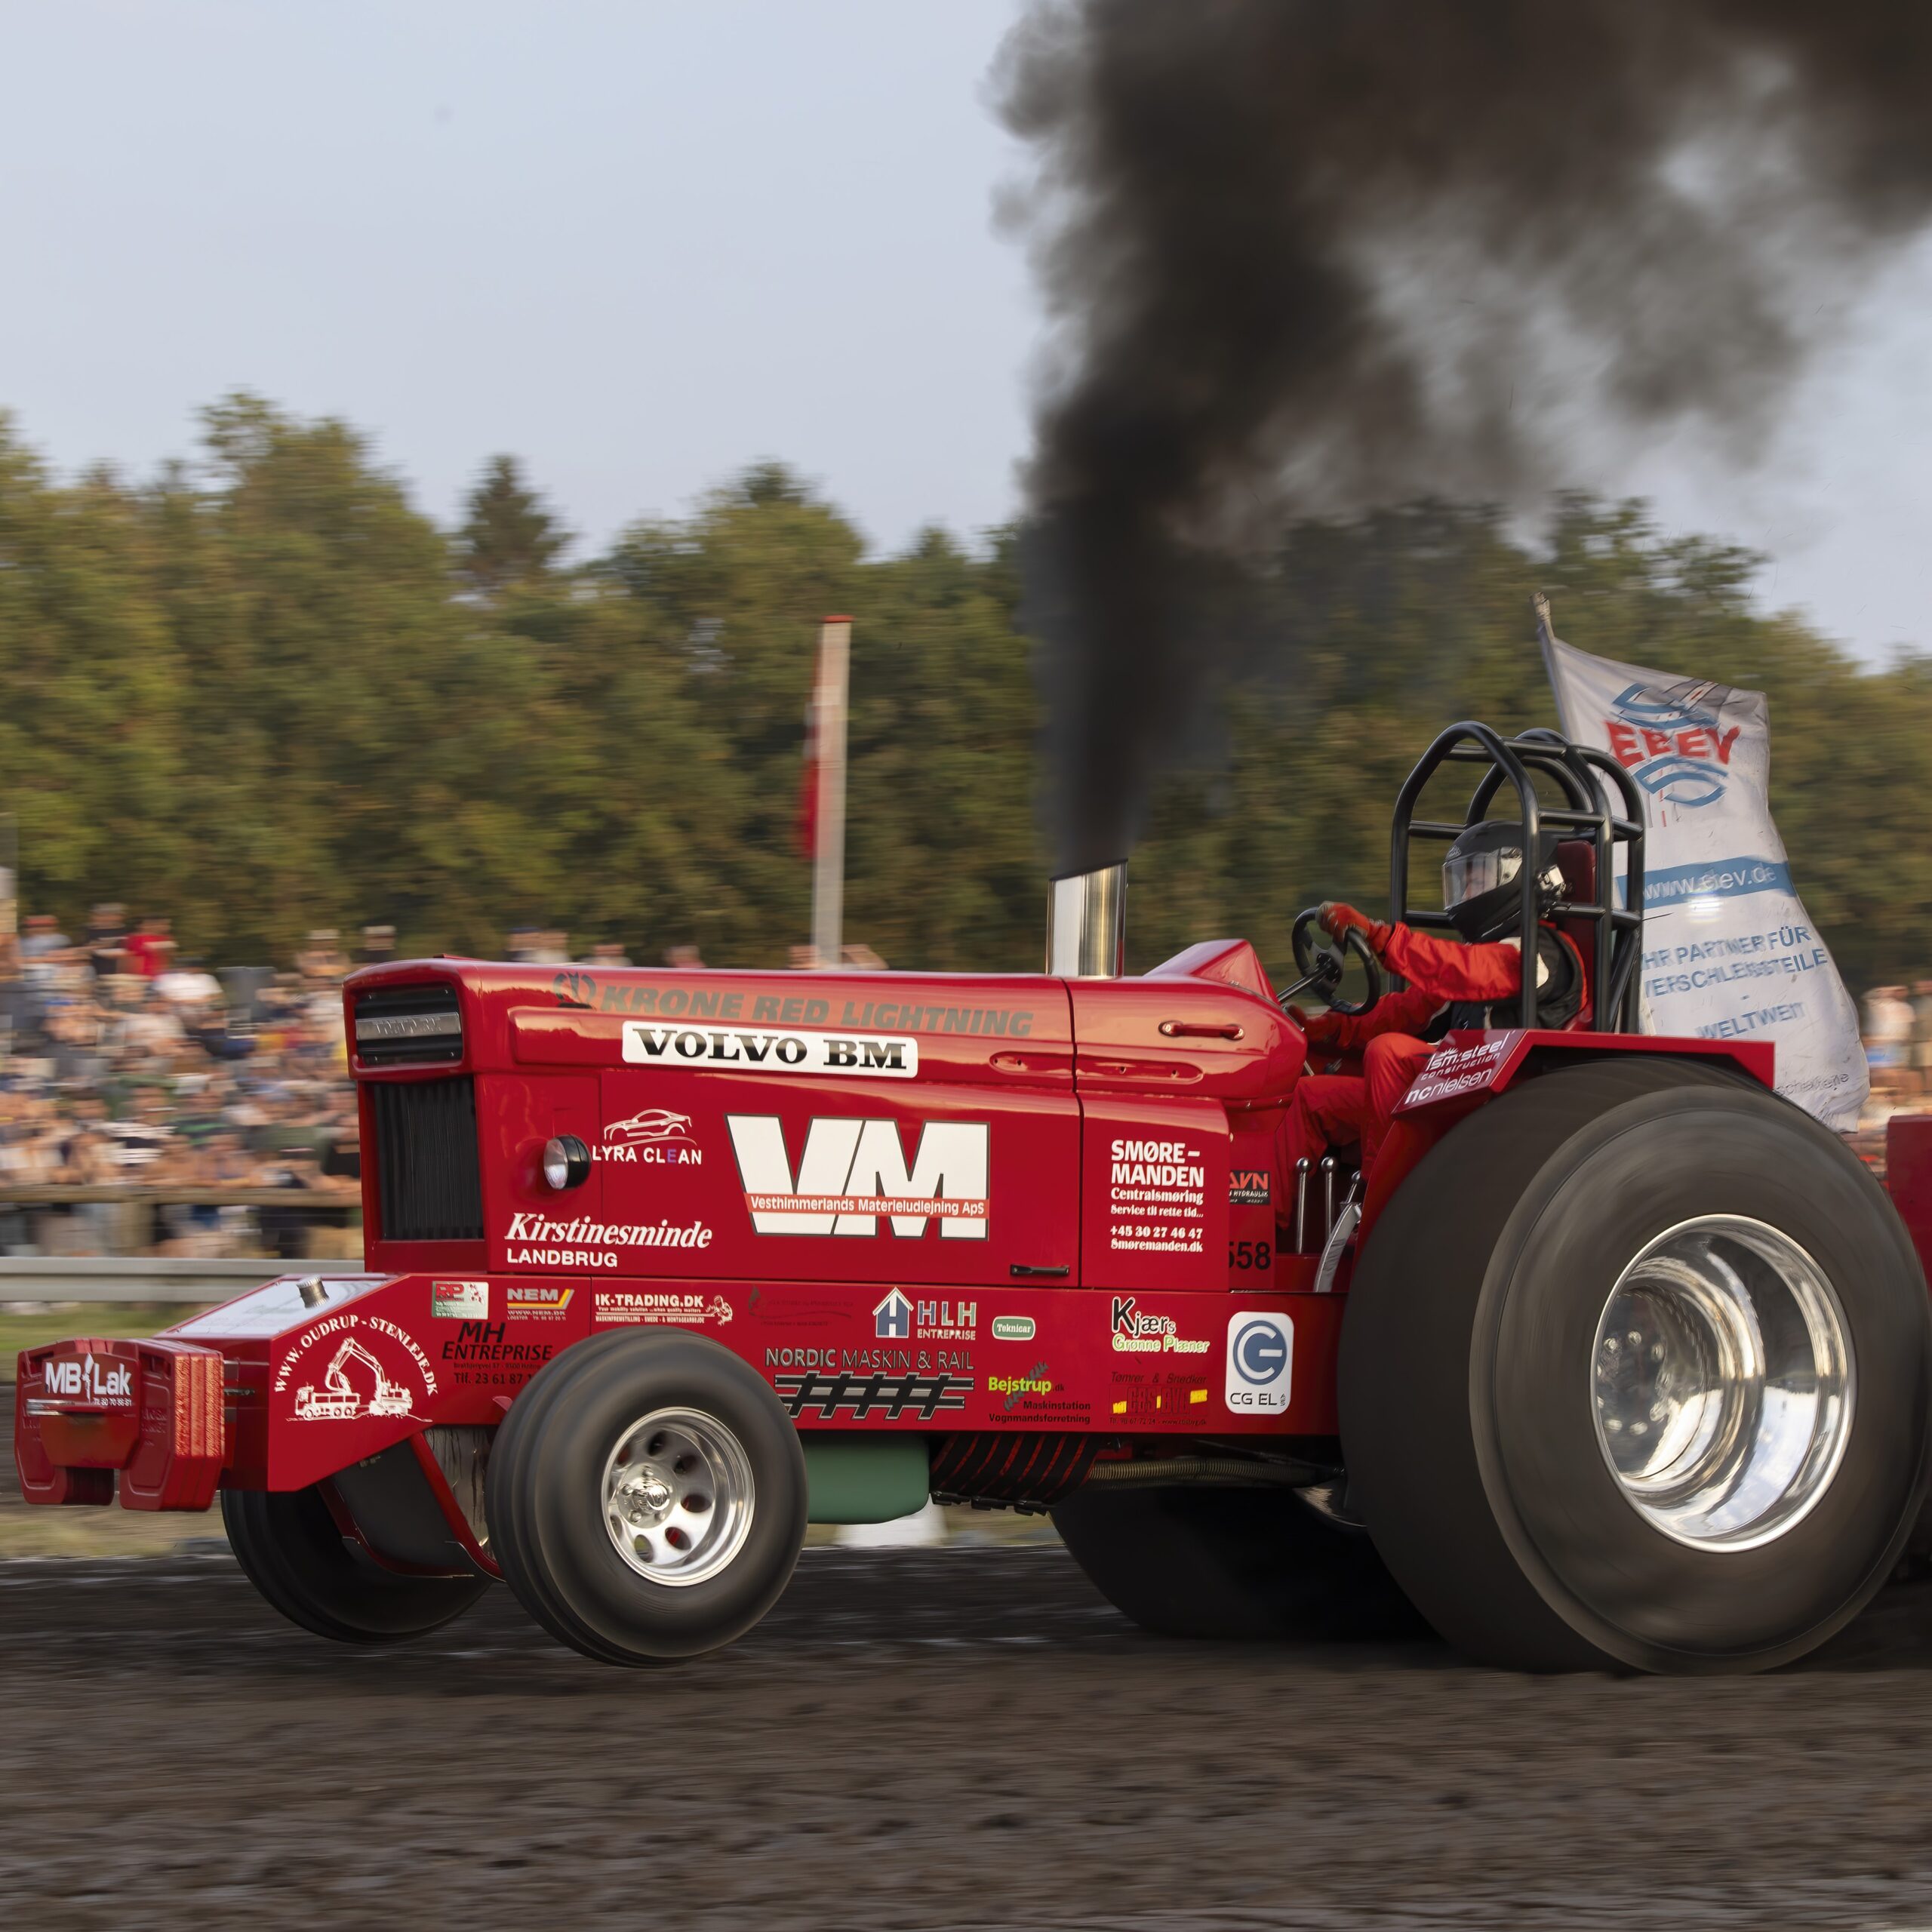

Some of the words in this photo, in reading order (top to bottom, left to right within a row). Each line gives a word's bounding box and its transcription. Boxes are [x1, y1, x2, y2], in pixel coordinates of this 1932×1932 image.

[1641, 948, 1673, 971] HR
[1767, 925, 1812, 950] FÜR
[601, 986, 744, 1018] KRONE
[752, 995, 829, 1025] RED
[840, 1001, 1034, 1036] LIGHTNING
[632, 1029, 808, 1064] VOLVO
[823, 1039, 906, 1069] BM
[1421, 1052, 1500, 1081] construction
[592, 1145, 637, 1162] LYRA
[643, 1147, 702, 1164] CLEAN
[1111, 1163, 1204, 1187] MANDEN
[751, 1195, 854, 1211] Vesthimmerlands
[859, 1198, 958, 1216] Materieludlejning
[962, 1201, 984, 1216] ApS
[1111, 1187, 1204, 1205] Centralsmøring
[1111, 1204, 1145, 1216] Service
[1146, 1205, 1157, 1216] til
[1158, 1207, 1182, 1217] rette
[504, 1212, 712, 1248] Kirstinesminde
[1110, 1226, 1132, 1236] +45
[1135, 1226, 1151, 1237] 30
[1153, 1226, 1168, 1238] 27
[1188, 1228, 1203, 1239] 47
[1111, 1238, 1203, 1252] Smøremanden.dk
[506, 1248, 617, 1267] LANDBRUG
[507, 1288, 558, 1301] NEM
[595, 1294, 703, 1308] IK-TRADING.DK
[917, 1300, 977, 1327] HLH
[1112, 1297, 1176, 1338] Kjærs
[457, 1321, 506, 1343] MH
[917, 1328, 977, 1340] ENTREPRISE
[1112, 1333, 1161, 1352] Grønne
[1163, 1334, 1210, 1353] Plæner
[765, 1348, 836, 1367] NORDIC
[842, 1349, 911, 1369] MASKIN
[917, 1350, 932, 1369] &
[937, 1351, 974, 1370] RAIL
[45, 1362, 82, 1394] MB
[94, 1363, 131, 1395] Lak
[454, 1373, 471, 1384] Tlf.
[475, 1374, 488, 1384] 23
[492, 1374, 505, 1384] 61
[509, 1374, 522, 1384] 87
[1167, 1373, 1207, 1384] Snedker
[1023, 1401, 1091, 1410] Maskinstation
[1230, 1392, 1252, 1405] CG
[1258, 1393, 1278, 1405] EL
[989, 1414, 1091, 1424] Vognmandsforretning
